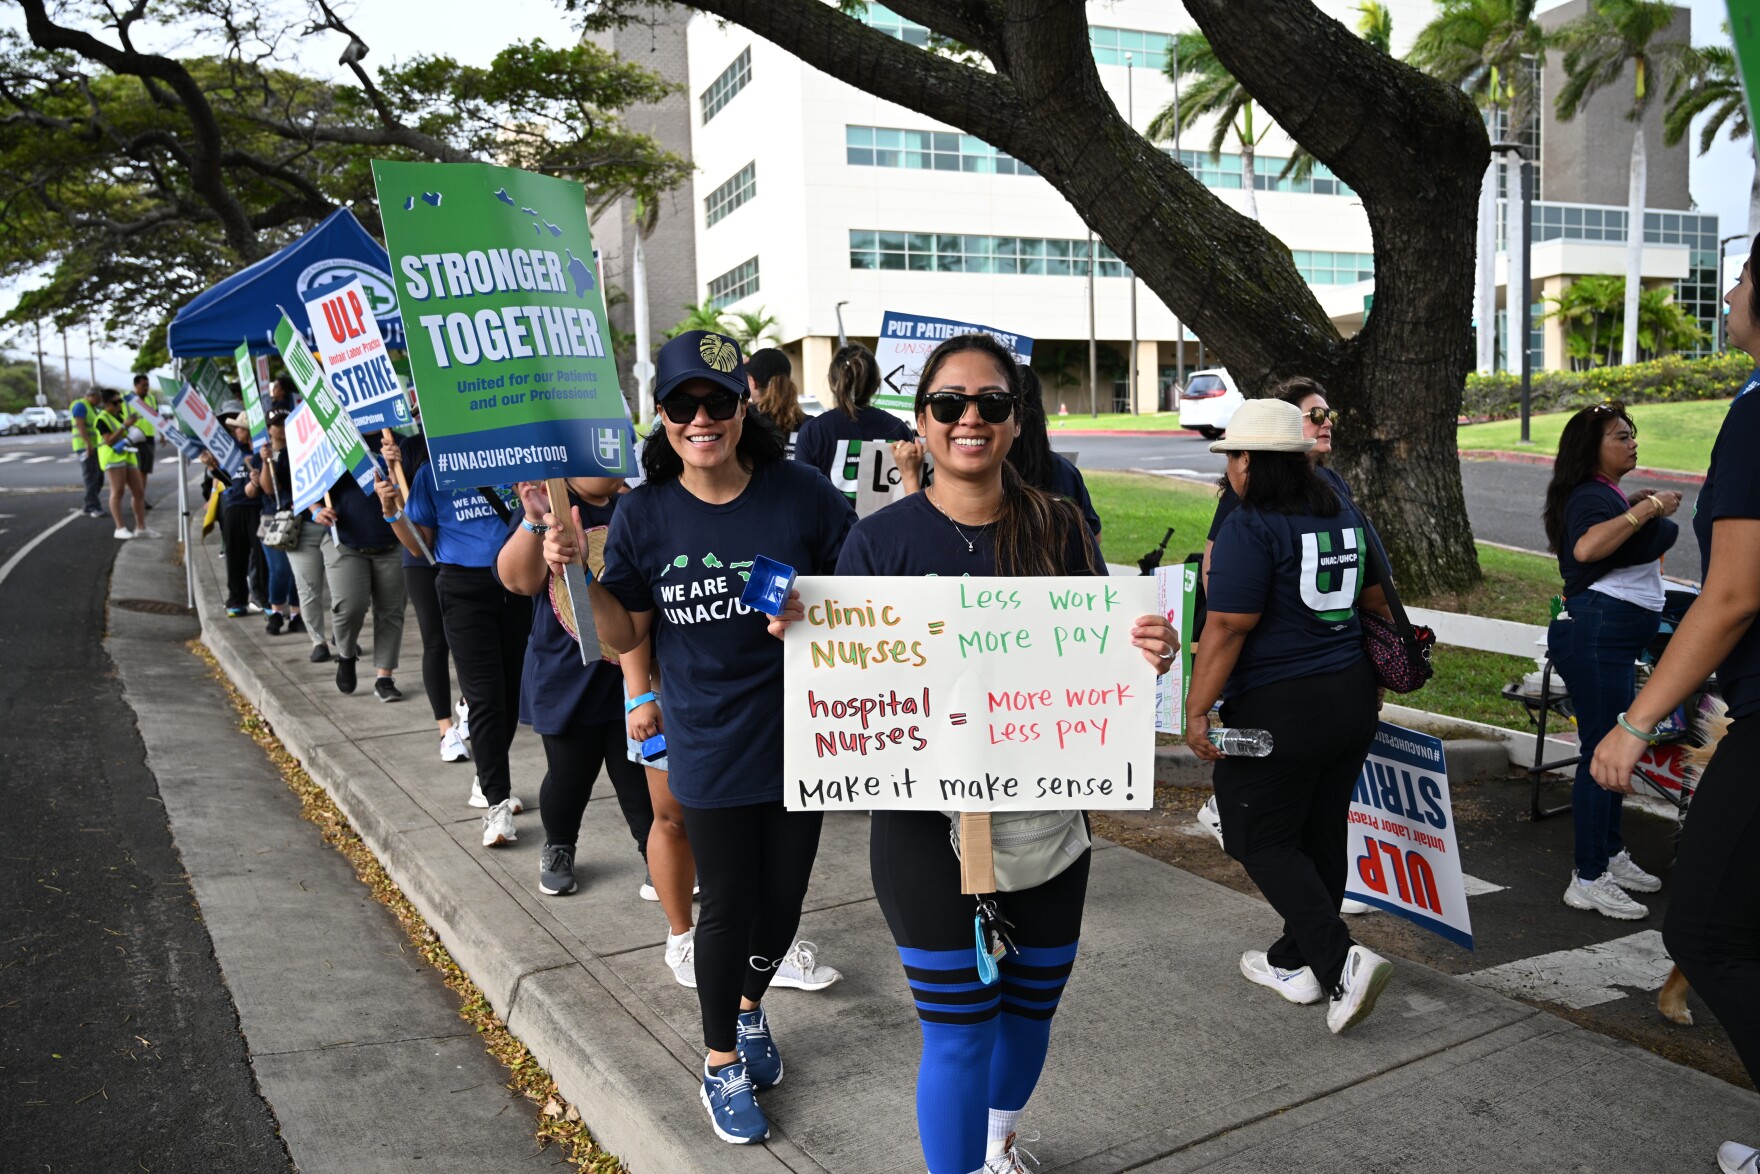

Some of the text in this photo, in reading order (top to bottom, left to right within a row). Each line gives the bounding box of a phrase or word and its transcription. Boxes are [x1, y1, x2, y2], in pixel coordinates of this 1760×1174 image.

[400, 248, 568, 301] STRONGER
[322, 290, 367, 344] ULP
[346, 346, 362, 360] Labor
[362, 338, 381, 353] Practice
[419, 305, 606, 369] TOGETHER
[887, 320, 913, 336] PUT
[982, 329, 1019, 347] RST
[894, 342, 938, 354] UNSA
[289, 340, 315, 386] UNIT
[331, 354, 397, 408] STRIKE
[457, 370, 598, 393] United for our Patients
[185, 390, 210, 421] UL
[470, 387, 598, 410] and our Professions!
[295, 406, 317, 444] UL
[326, 411, 360, 460] PATIE
[295, 436, 336, 492] STRIK
[437, 445, 568, 471] #UNACUHCPstrong
[453, 495, 489, 509] WE ARE
[1320, 553, 1358, 566] UNAC/UHCP
[661, 576, 728, 602] WE ARE
[960, 583, 1121, 613] Less work
[664, 597, 757, 625] UNAC/U
[808, 599, 902, 630] clinic
[810, 640, 928, 670] Nurses
[957, 623, 1110, 659] More pay
[808, 686, 931, 730] hospital
[988, 688, 1053, 713] More
[1065, 682, 1135, 708] work
[815, 724, 928, 758] Nurses
[988, 717, 1110, 749] Less pay
[1374, 731, 1441, 762] #UNACUHCPstr
[798, 775, 881, 808] Make
[892, 767, 918, 799] it
[939, 772, 1019, 802] make
[1351, 760, 1447, 830] STRI
[1347, 809, 1446, 853] Unfair Labor Practi
[1357, 835, 1443, 916] ULP
